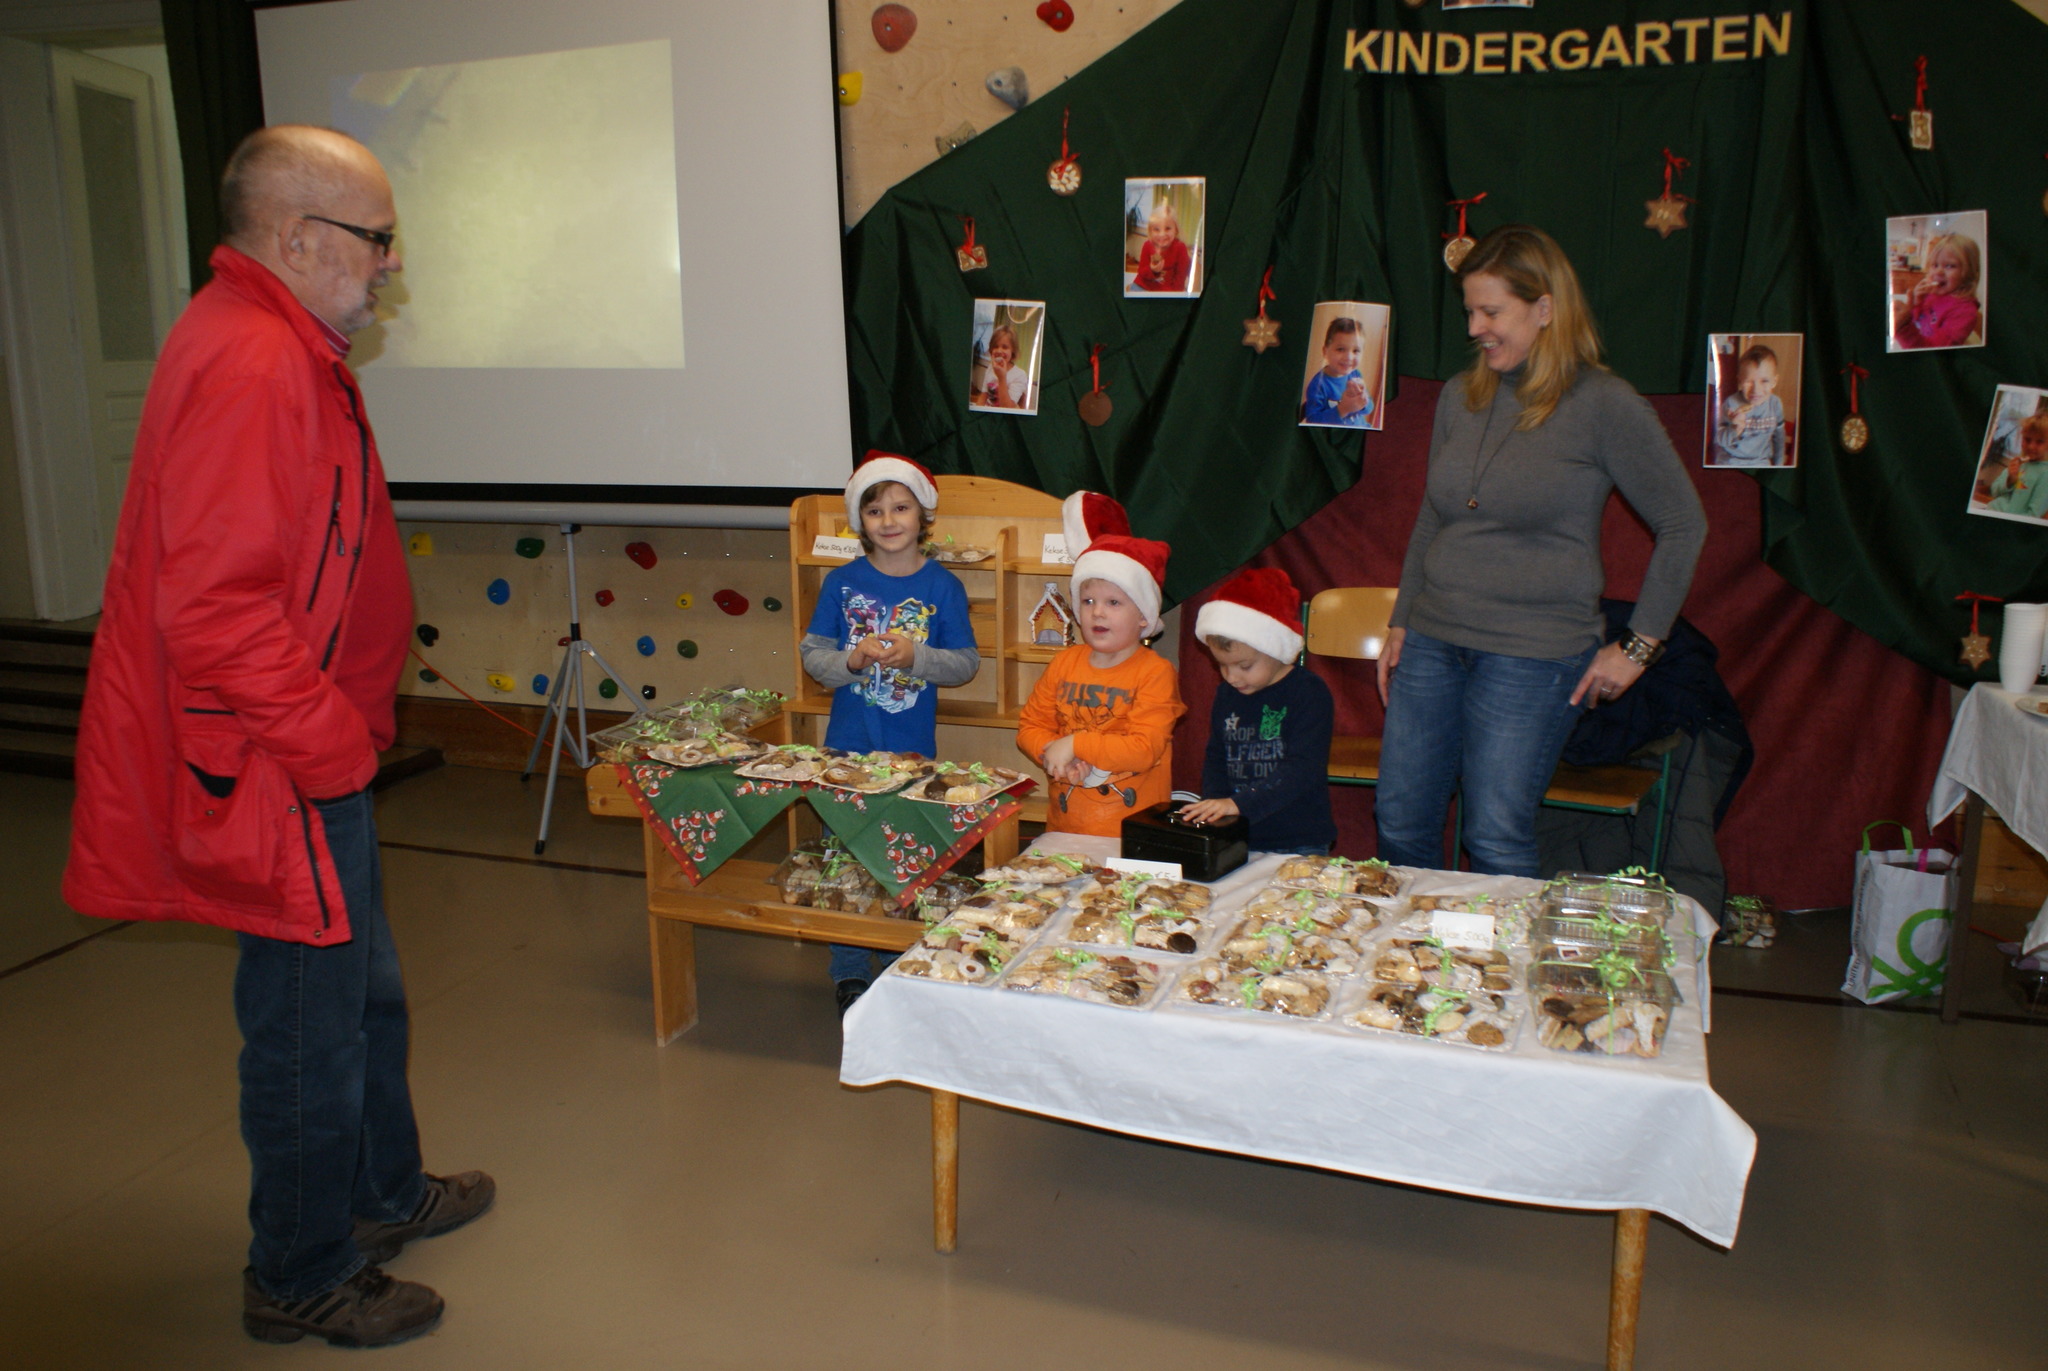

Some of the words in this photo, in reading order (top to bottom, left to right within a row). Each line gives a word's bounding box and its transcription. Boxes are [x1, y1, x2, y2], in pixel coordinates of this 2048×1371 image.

[1344, 11, 1792, 75] KINDERGARTEN
[1226, 741, 1284, 761] LFIGER
[1847, 958, 1864, 987] UNITED
